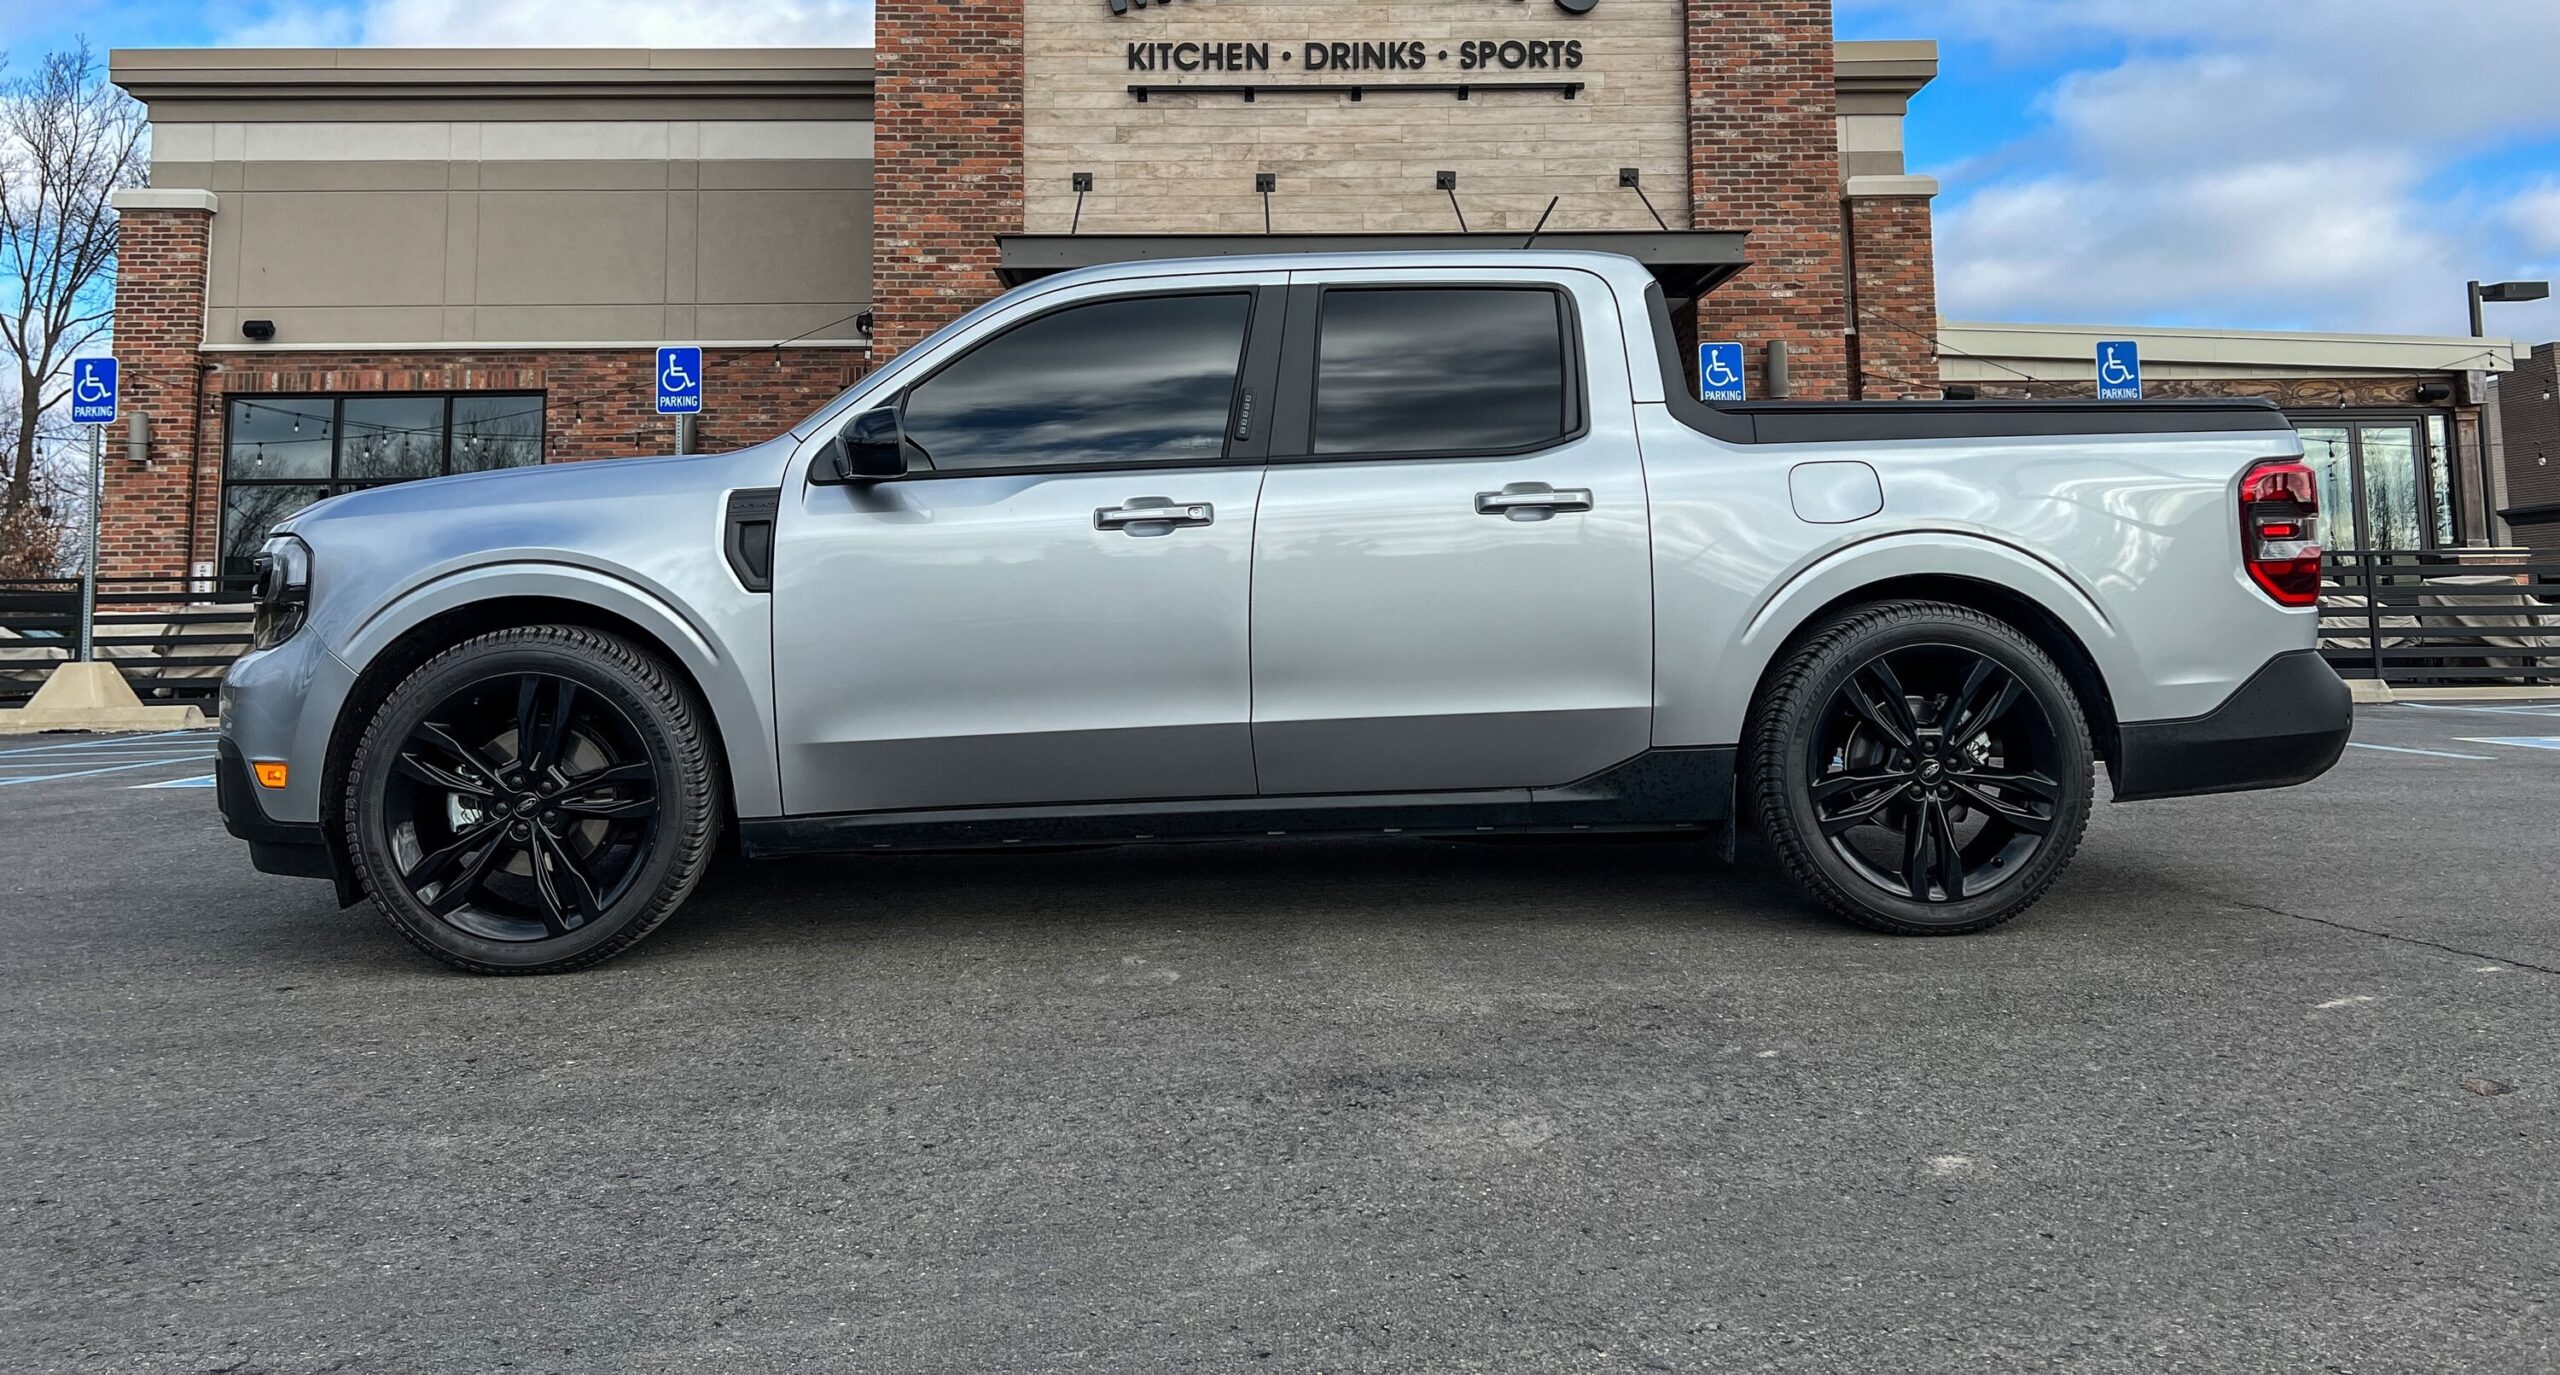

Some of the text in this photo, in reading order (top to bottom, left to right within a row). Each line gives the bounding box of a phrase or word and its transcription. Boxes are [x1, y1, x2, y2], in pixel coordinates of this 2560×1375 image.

[1128, 40, 1584, 71] KITCHEN DRINKS SPORTS
[1705, 391, 1742, 402] PARKING
[2102, 388, 2138, 400] PARKING
[660, 396, 698, 408] PARKING
[74, 406, 113, 418] PARKING
